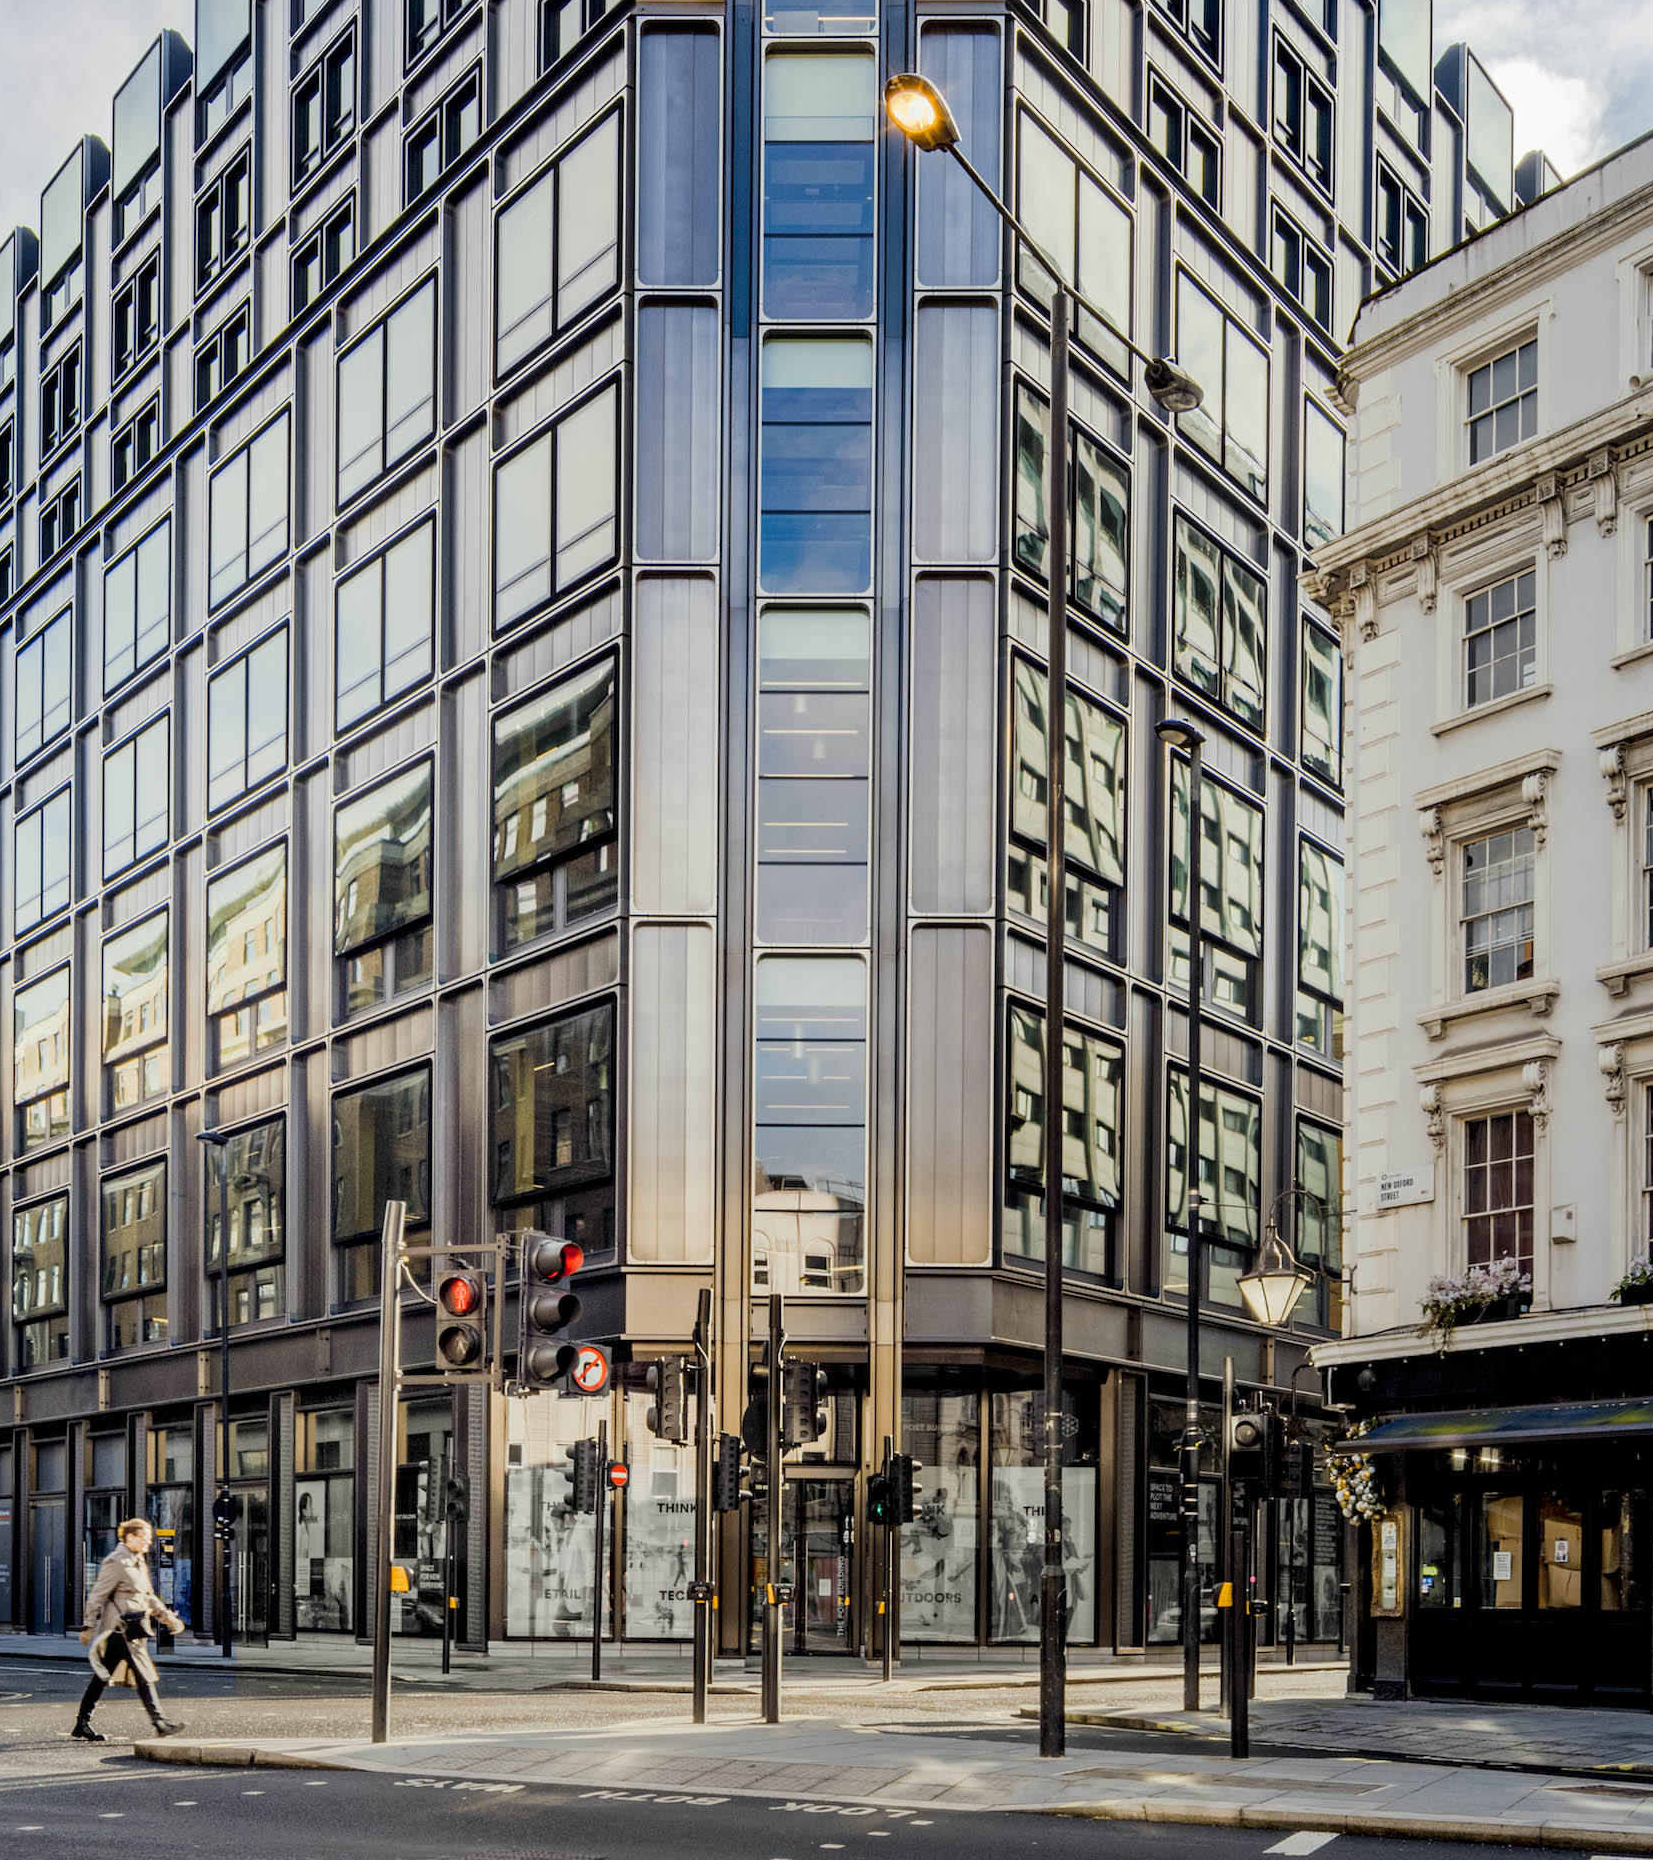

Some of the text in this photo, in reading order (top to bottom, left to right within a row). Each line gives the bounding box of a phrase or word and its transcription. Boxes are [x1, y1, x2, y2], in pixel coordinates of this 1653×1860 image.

[1381, 1178, 1414, 1190] NEW OXFORD
[1381, 1190, 1399, 1201] STREET
[657, 1503, 697, 1514] THINK
[837, 1555, 845, 1595] BUILDING
[658, 1590, 688, 1601] TEC
[837, 1620, 845, 1637] THE
[394, 1778, 918, 1819] LOOK BOTH WAYS
